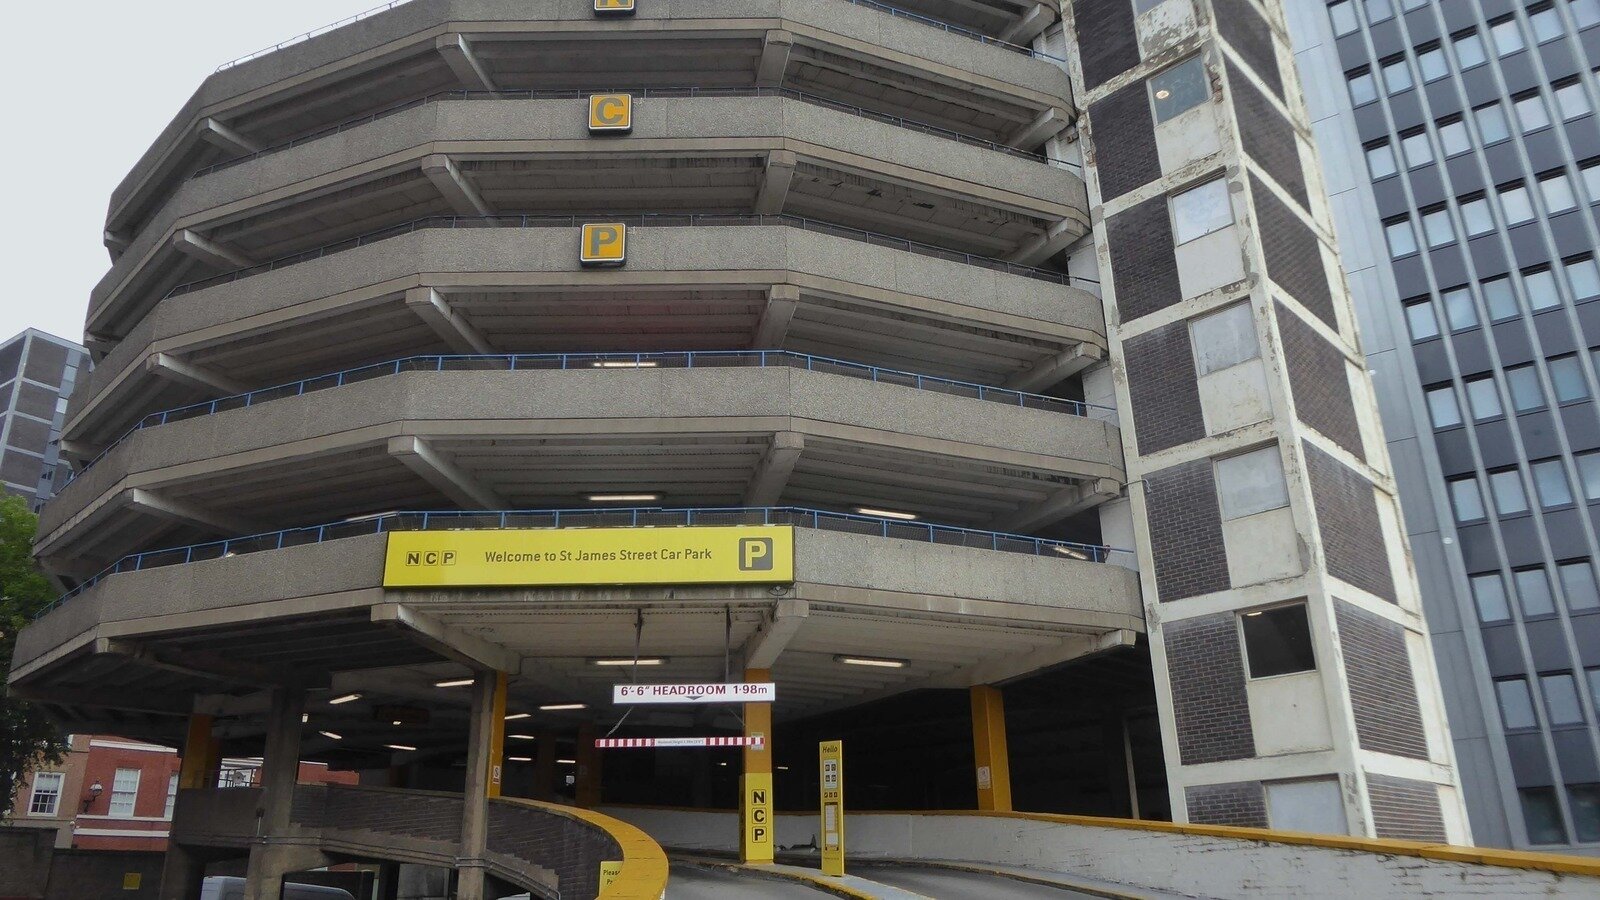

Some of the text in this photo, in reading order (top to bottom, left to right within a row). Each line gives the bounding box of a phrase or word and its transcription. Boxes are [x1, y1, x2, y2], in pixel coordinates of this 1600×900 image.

[595, 97, 624, 125] C
[590, 227, 618, 256] P
[407, 541, 767, 568] NCP Welcome to St James Street Car Park P
[653, 685, 726, 696] HEADROOM
[822, 745, 838, 754] Hello
